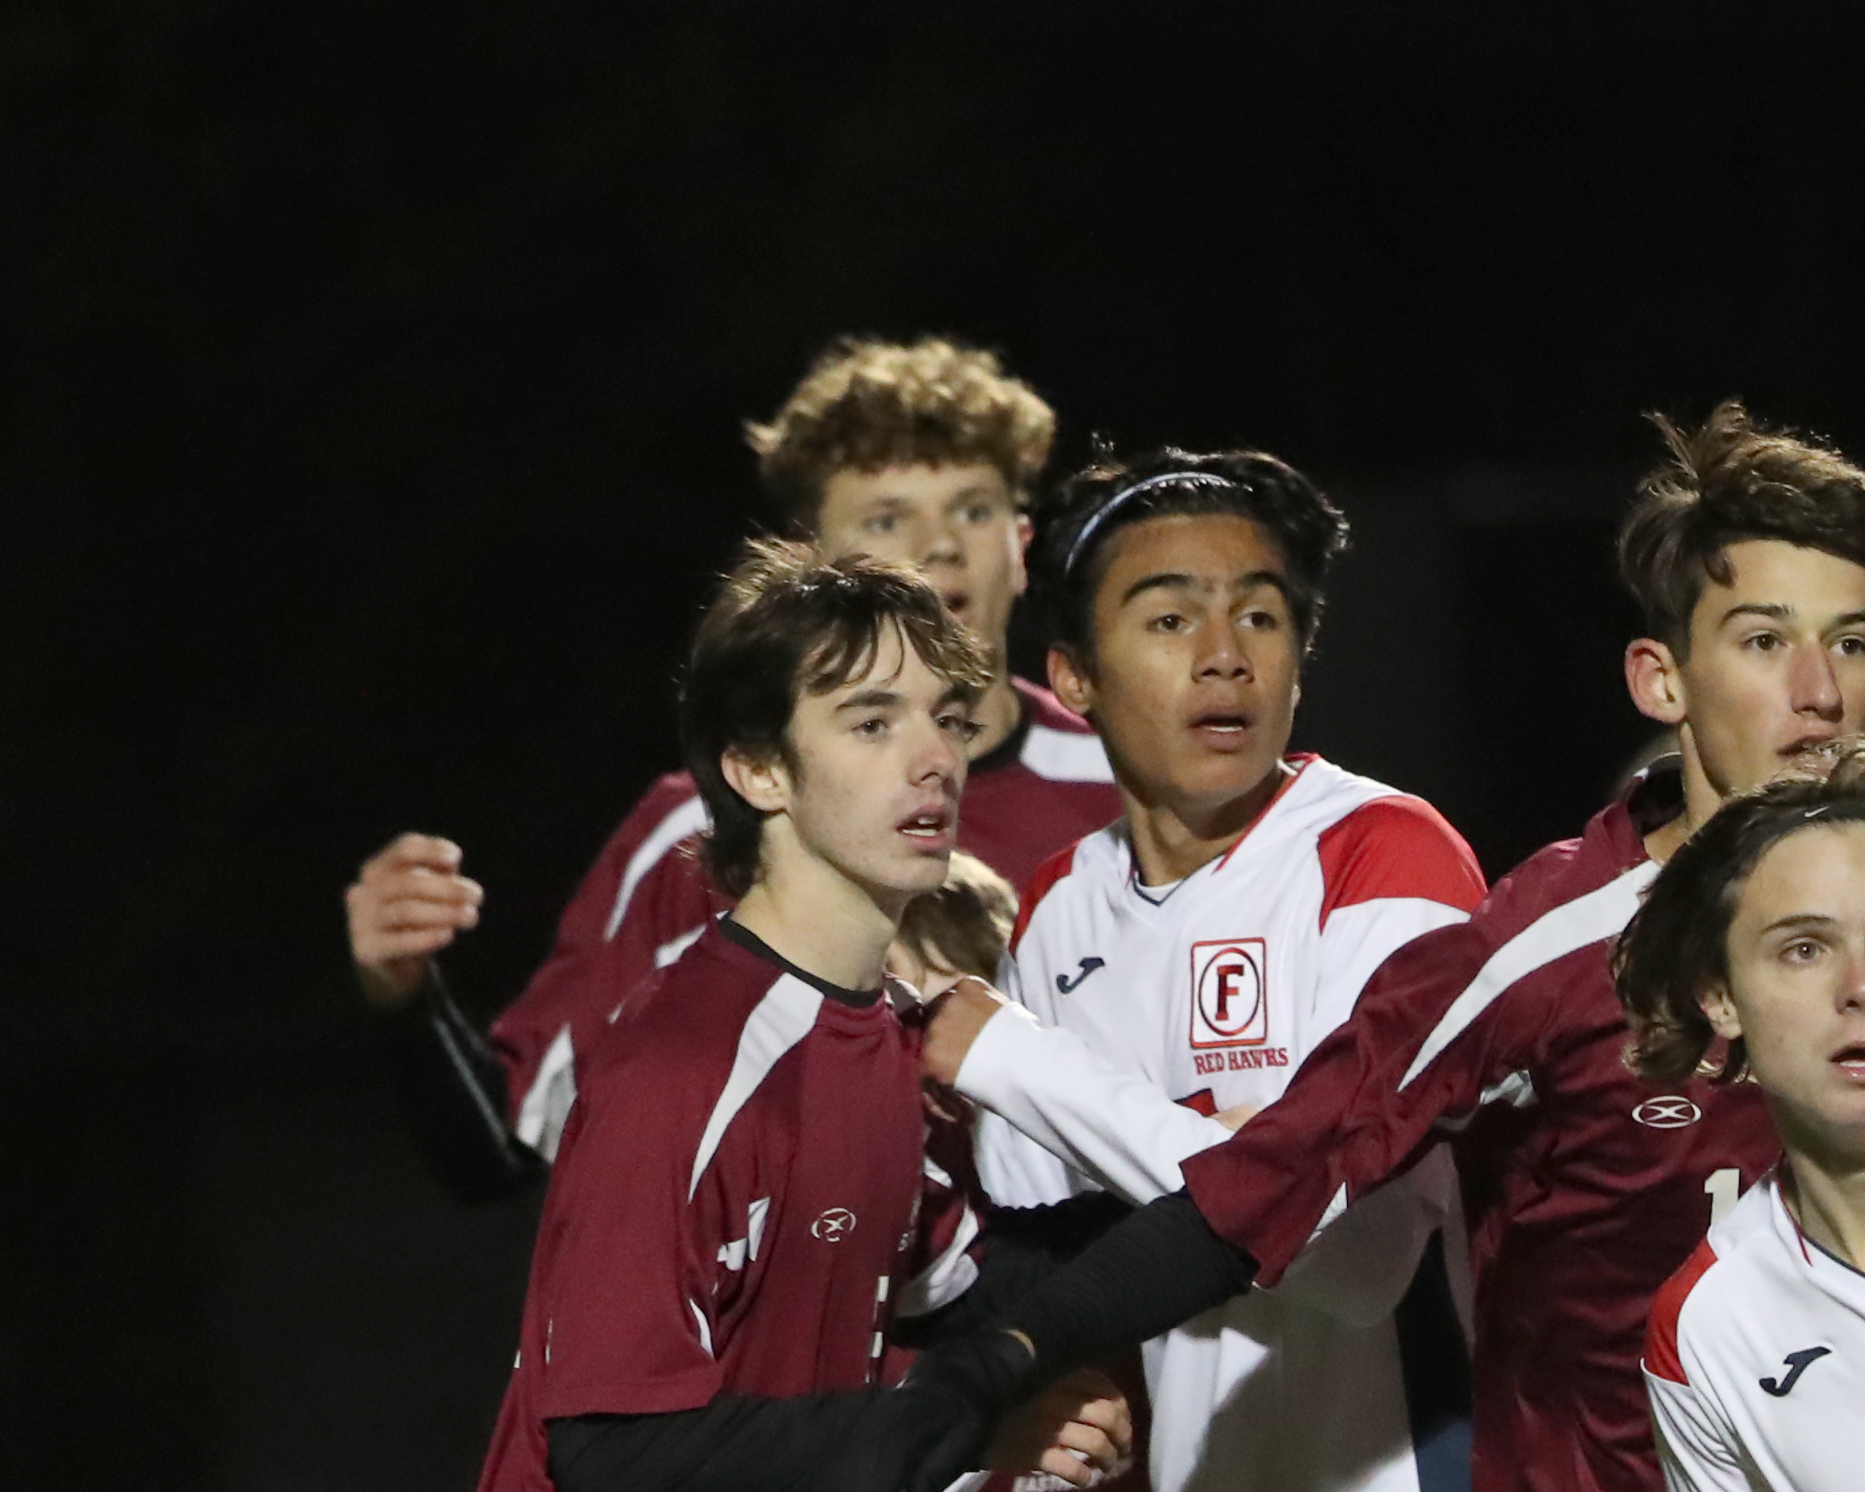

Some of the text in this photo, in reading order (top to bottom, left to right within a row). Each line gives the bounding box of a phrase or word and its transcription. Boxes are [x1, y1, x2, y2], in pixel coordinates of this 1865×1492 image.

[1215, 964, 1245, 1021] F
[1193, 1047, 1289, 1075] RED HAWKS
